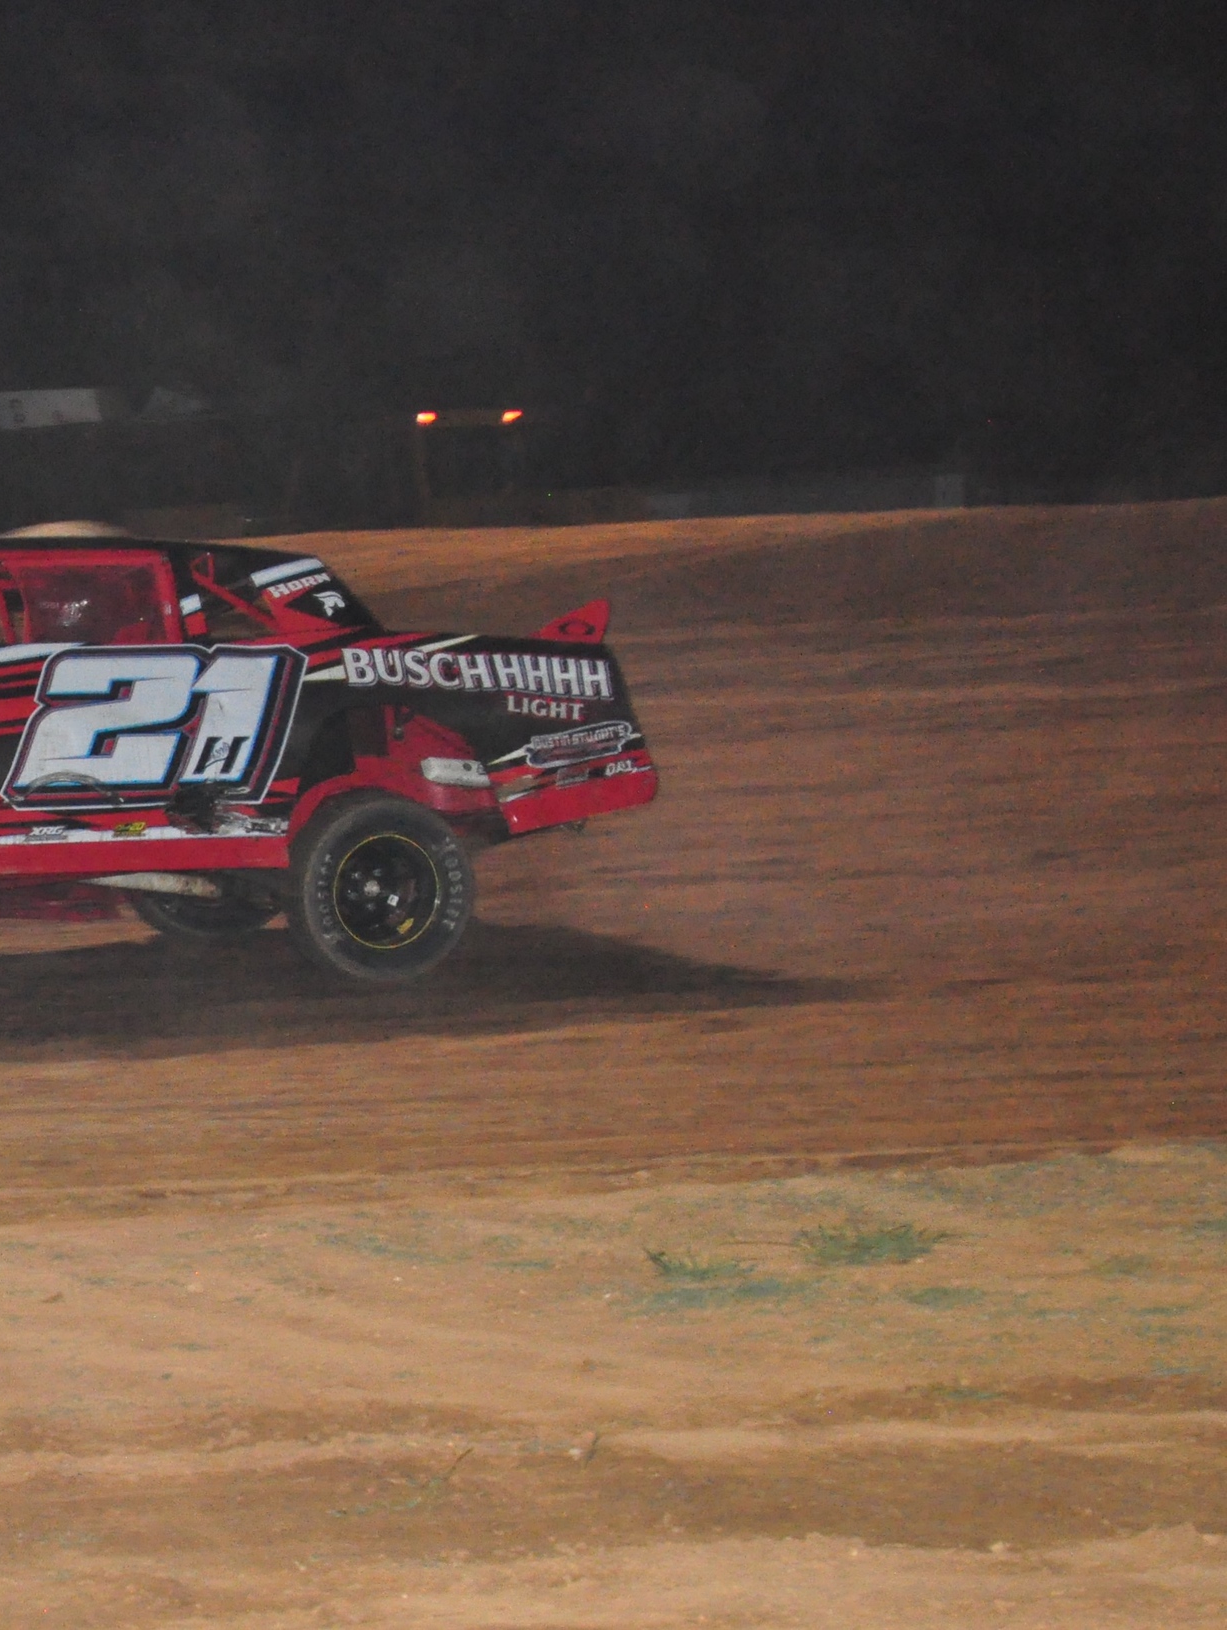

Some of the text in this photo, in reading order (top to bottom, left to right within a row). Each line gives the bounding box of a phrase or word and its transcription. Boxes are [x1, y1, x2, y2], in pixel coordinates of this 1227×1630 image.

[266, 572, 330, 598] HORN
[341, 648, 614, 700] BUSCHHHHH
[10, 652, 281, 788] 21
[507, 695, 585, 720] LIGHT
